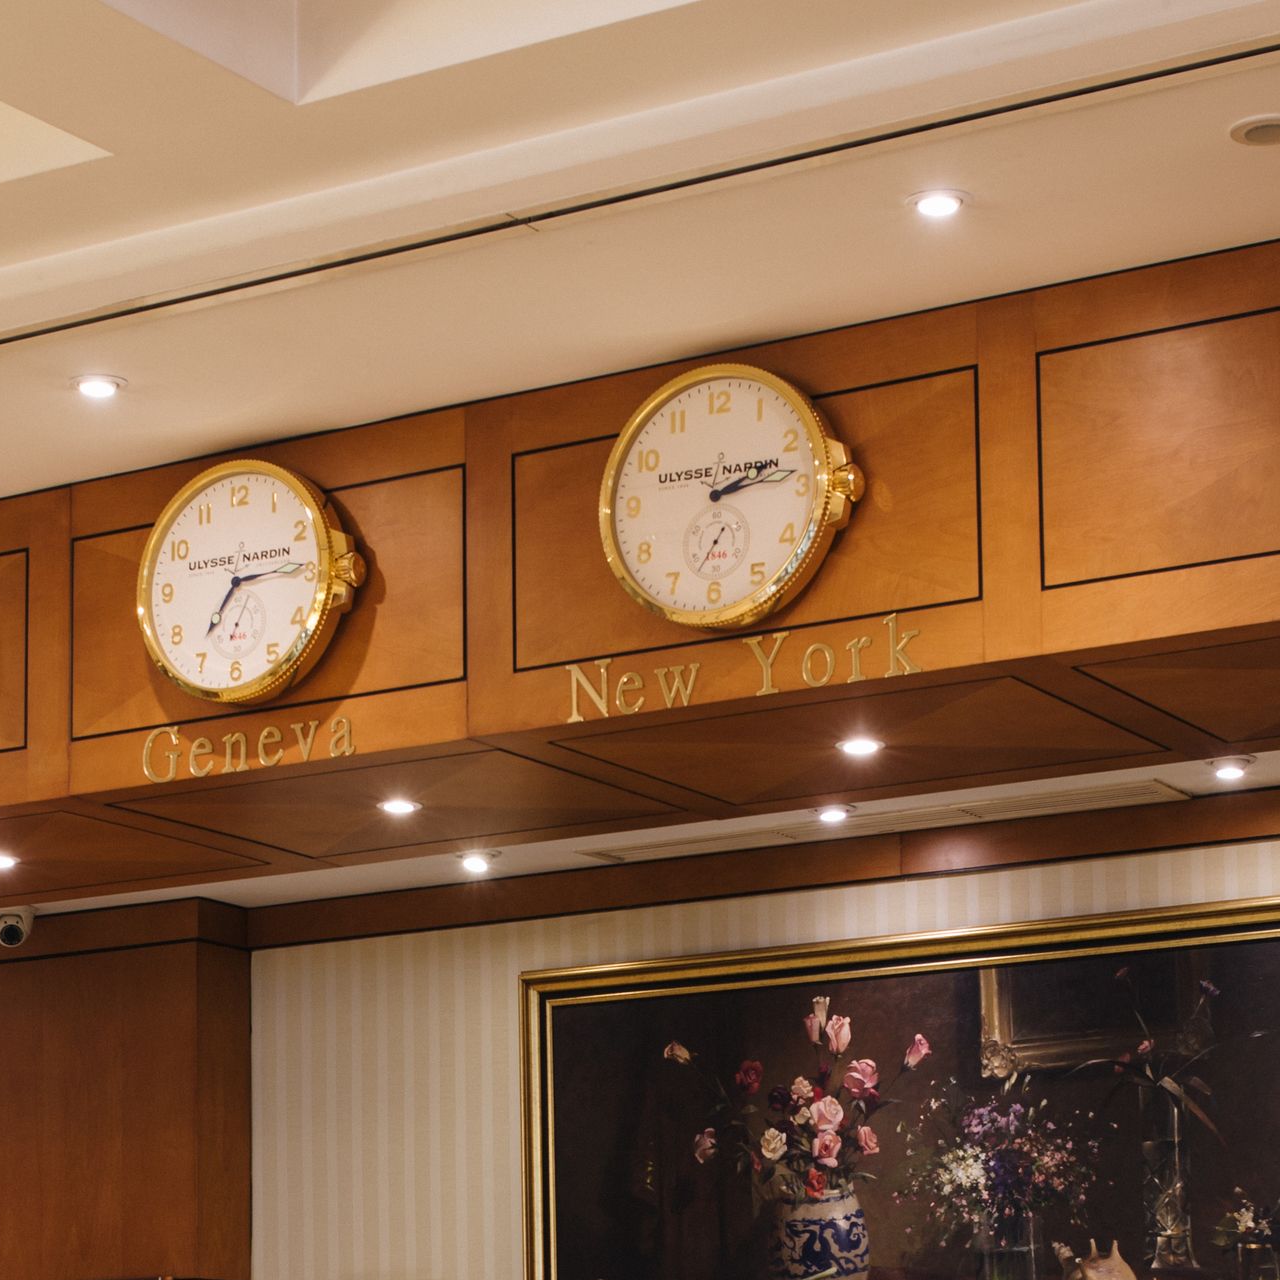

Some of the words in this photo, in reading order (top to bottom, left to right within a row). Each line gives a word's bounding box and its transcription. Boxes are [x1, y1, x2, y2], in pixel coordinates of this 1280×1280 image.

[709, 391, 731, 415] 12
[670, 410, 686, 433] 11
[783, 429, 798, 452] 2
[639, 449, 659, 472] 10
[659, 467, 713, 483] ULYSSE
[795, 474, 810, 497] 3
[231, 485, 249, 507] 12
[199, 504, 211, 525] 11
[626, 496, 641, 518] 9
[294, 520, 306, 541] 2
[779, 523, 796, 544] 4
[171, 540, 189, 561] 10
[189, 556, 234, 570] ULYSSE
[243, 547, 290, 561] NARDIN
[638, 542, 651, 563] 8
[305, 561, 316, 581] 3
[751, 562, 765, 585] 5
[162, 583, 173, 603] 9
[666, 571, 680, 595] 7
[707, 582, 721, 604] 6
[290, 606, 305, 627] 4
[171, 625, 183, 645] 8
[196, 653, 208, 673] 7
[267, 643, 279, 663] 5
[230, 661, 242, 681] 6
[566, 658, 701, 723] New
[743, 613, 922, 696] York
[142, 716, 355, 783] Geneva
